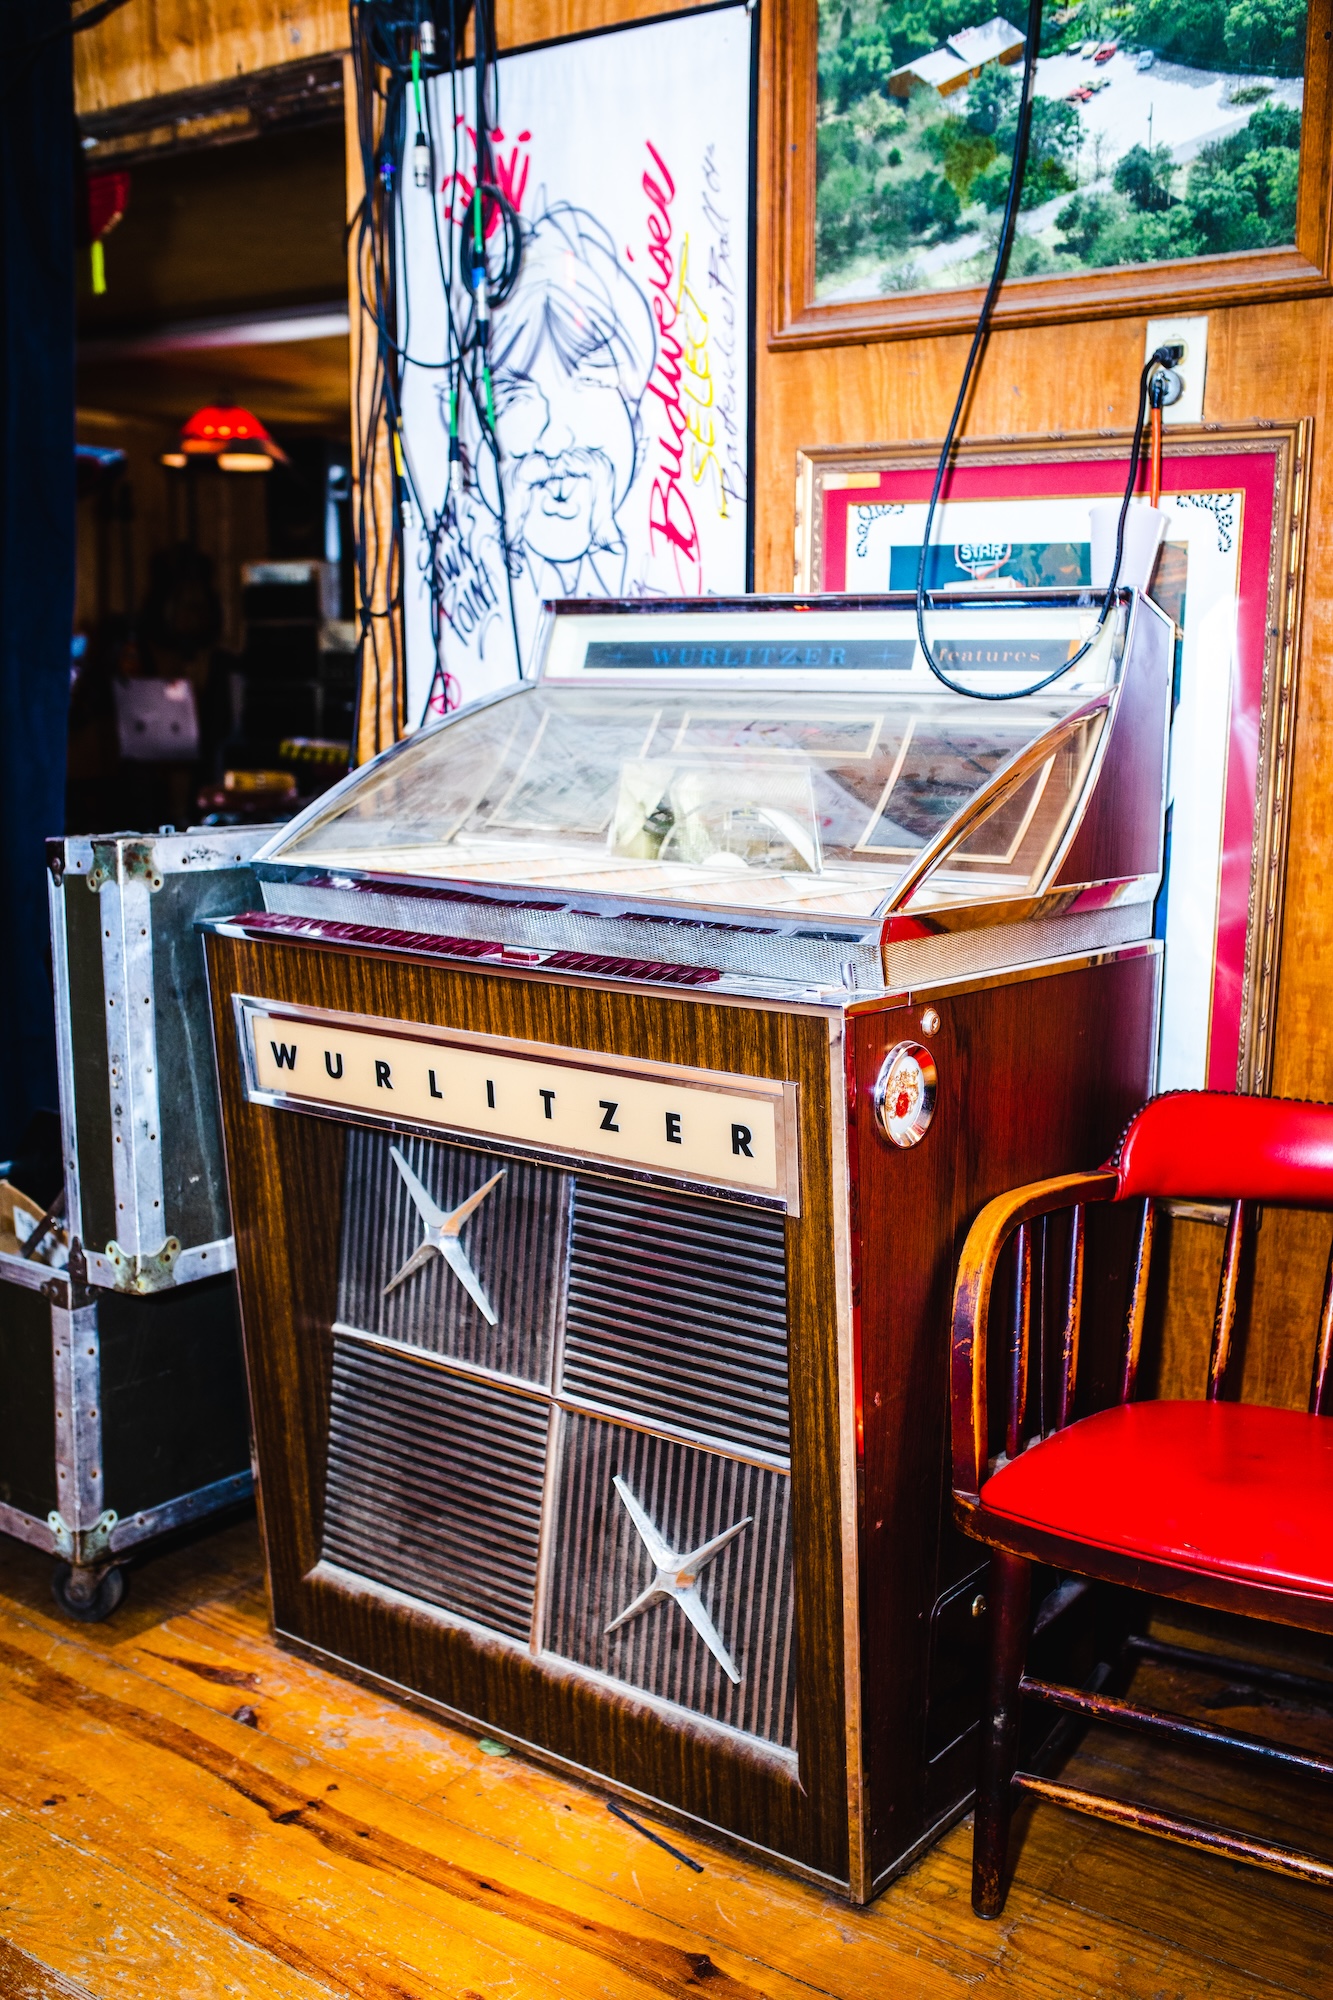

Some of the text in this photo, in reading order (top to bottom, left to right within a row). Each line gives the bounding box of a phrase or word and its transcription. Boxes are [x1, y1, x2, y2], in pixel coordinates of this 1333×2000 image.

[626, 140, 702, 595] Budweiser
[677, 231, 730, 519] SELECT
[651, 646, 1042, 666] WURLITZER features
[270, 1041, 755, 1158] WURLITZER
